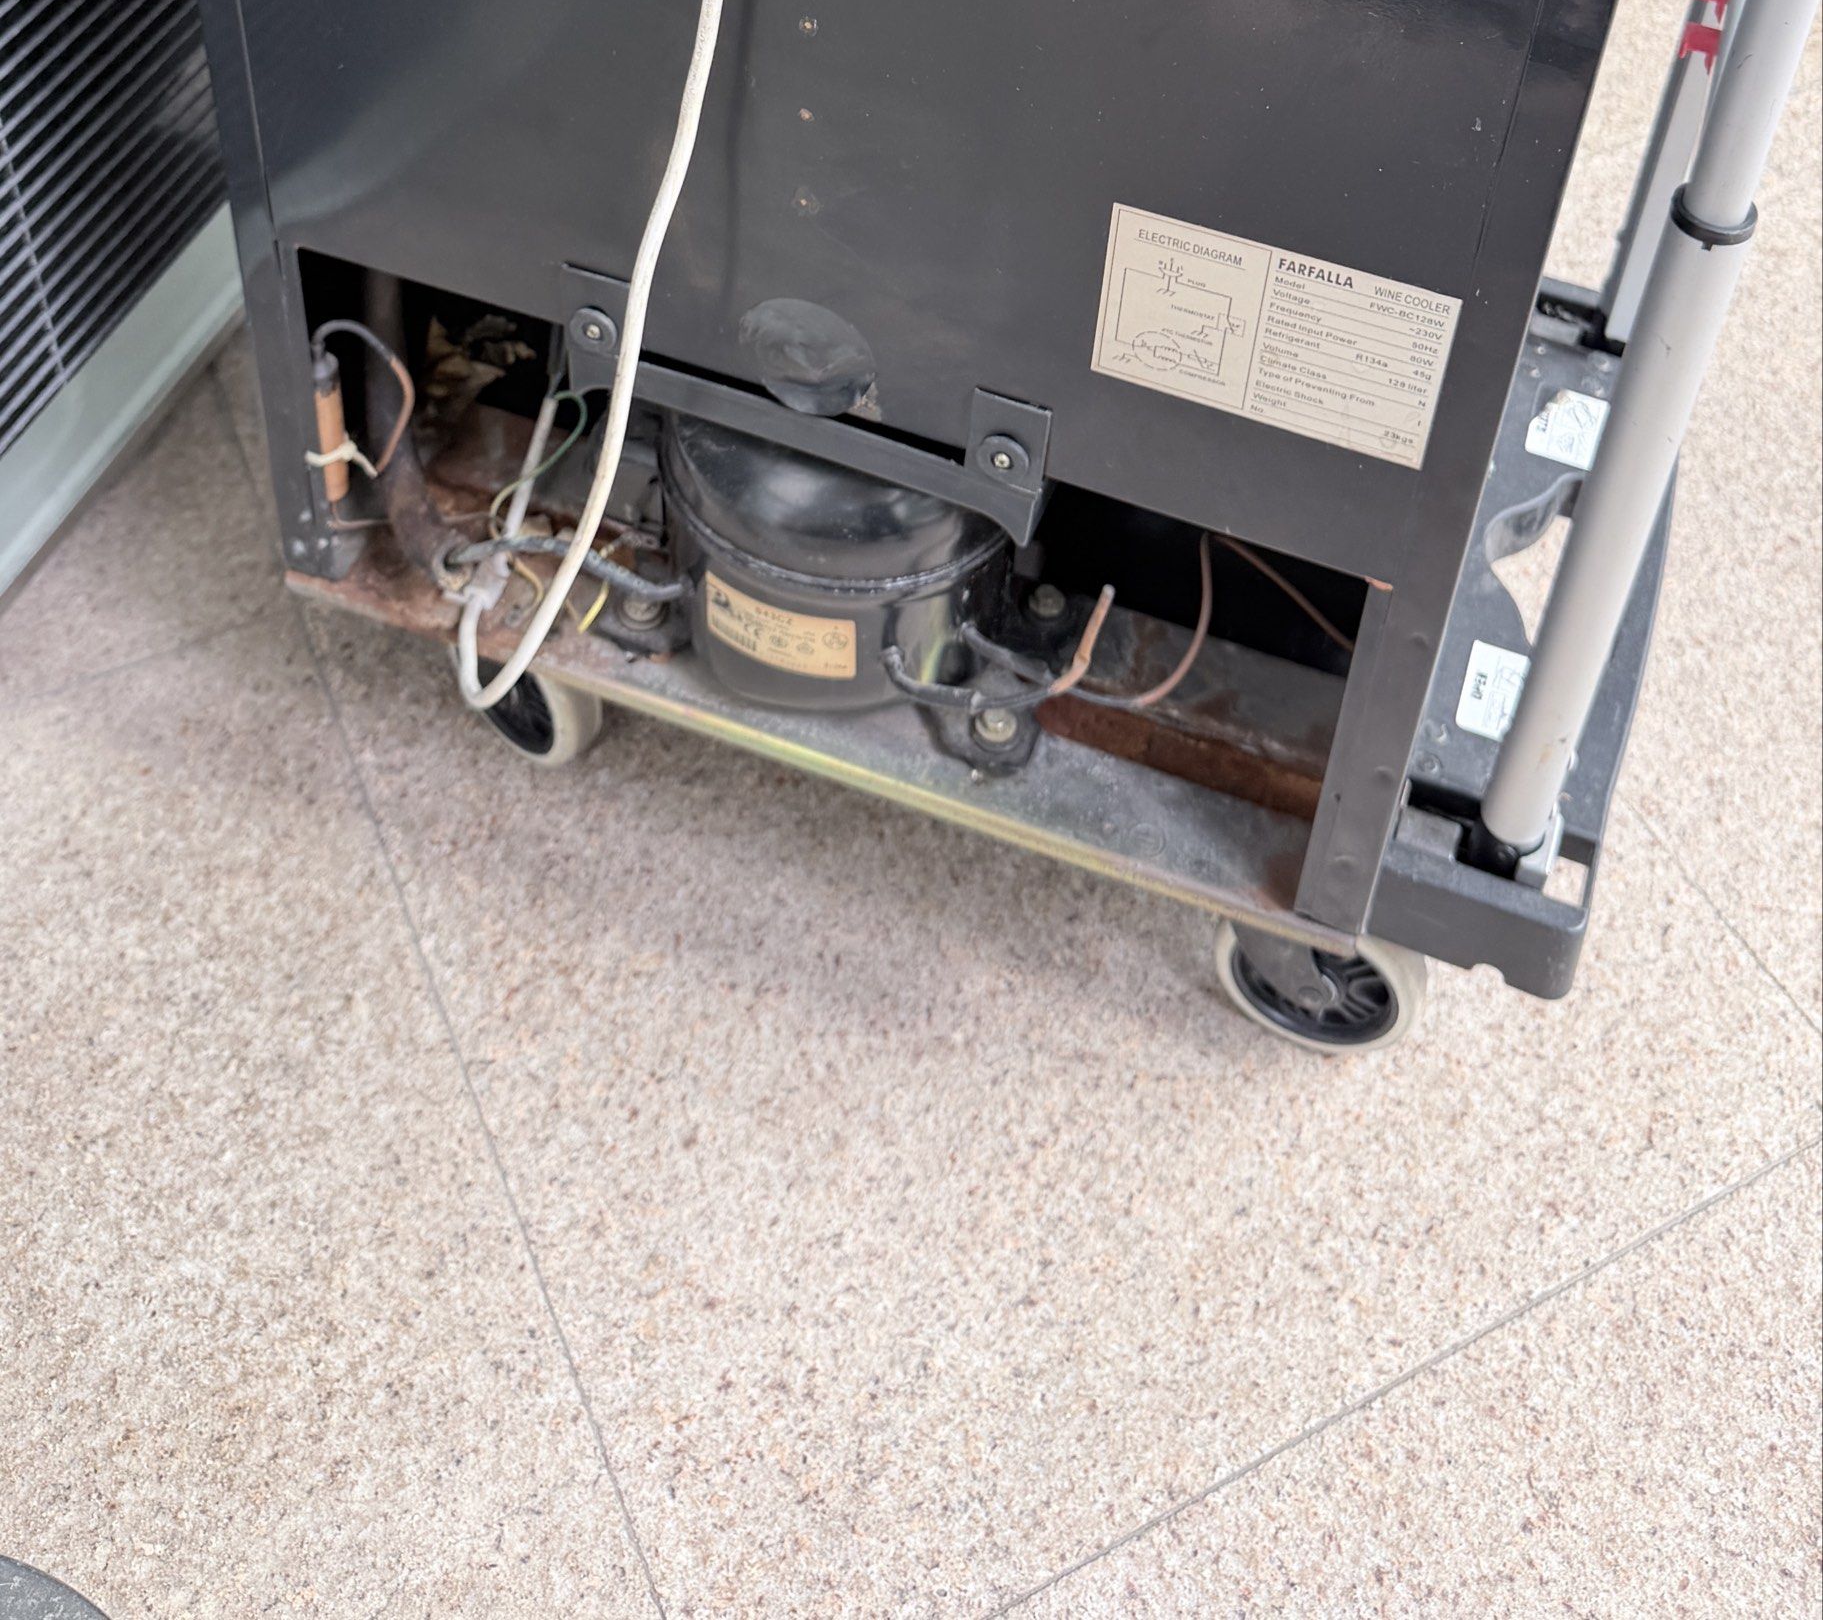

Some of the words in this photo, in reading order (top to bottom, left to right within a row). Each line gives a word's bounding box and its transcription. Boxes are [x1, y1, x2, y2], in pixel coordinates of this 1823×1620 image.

[1138, 228, 1192, 252] ELECTRIC
[1192, 243, 1243, 267] DIAGRAM
[1274, 275, 1306, 290] Model
[1278, 257, 1354, 289] FARFALLA
[1272, 288, 1311, 305] Voltage
[1374, 285, 1403, 300] WINE
[1403, 293, 1451, 316] COOLER
[1269, 301, 1322, 323] Frequency
[1264, 327, 1321, 349] Refrigerant
[1266, 314, 1297, 330] Rated
[1325, 331, 1358, 346] Power
[1262, 341, 1300, 358] Volume
[1259, 354, 1298, 372] Climate
[1299, 366, 1327, 380] Class
[1252, 391, 1287, 408] Weight
[1254, 379, 1292, 396] Electric
[1293, 390, 1325, 406] Shock
[1258, 366, 1281, 380] Type
[1282, 374, 1294, 382] of
[1294, 378, 1348, 400] Preventing
[1349, 393, 1376, 407] From
